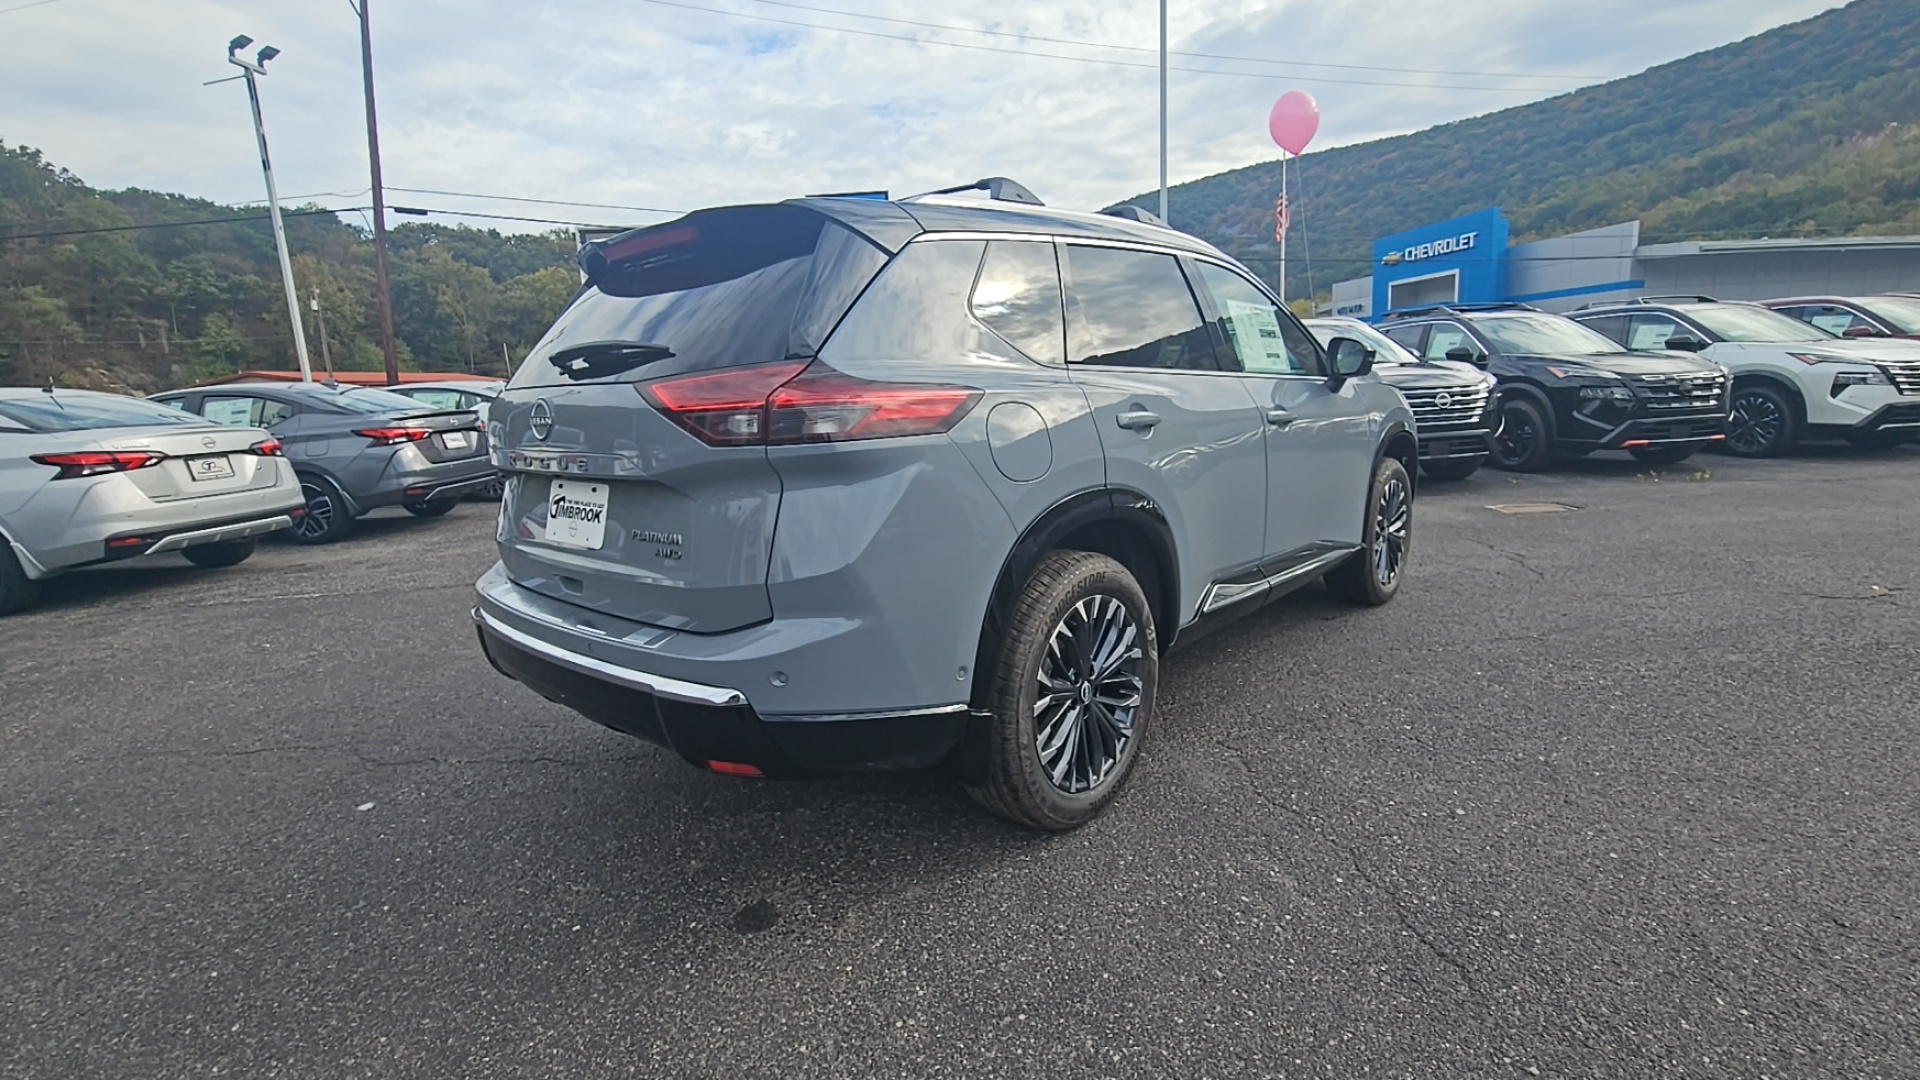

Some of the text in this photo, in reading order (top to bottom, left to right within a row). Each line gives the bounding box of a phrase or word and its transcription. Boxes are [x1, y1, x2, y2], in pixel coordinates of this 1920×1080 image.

[1404, 231, 1478, 261] CHEVROLET
[509, 455, 589, 472] ROGUE
[631, 528, 682, 546] PLATINUM
[654, 547, 682, 561] AWD
